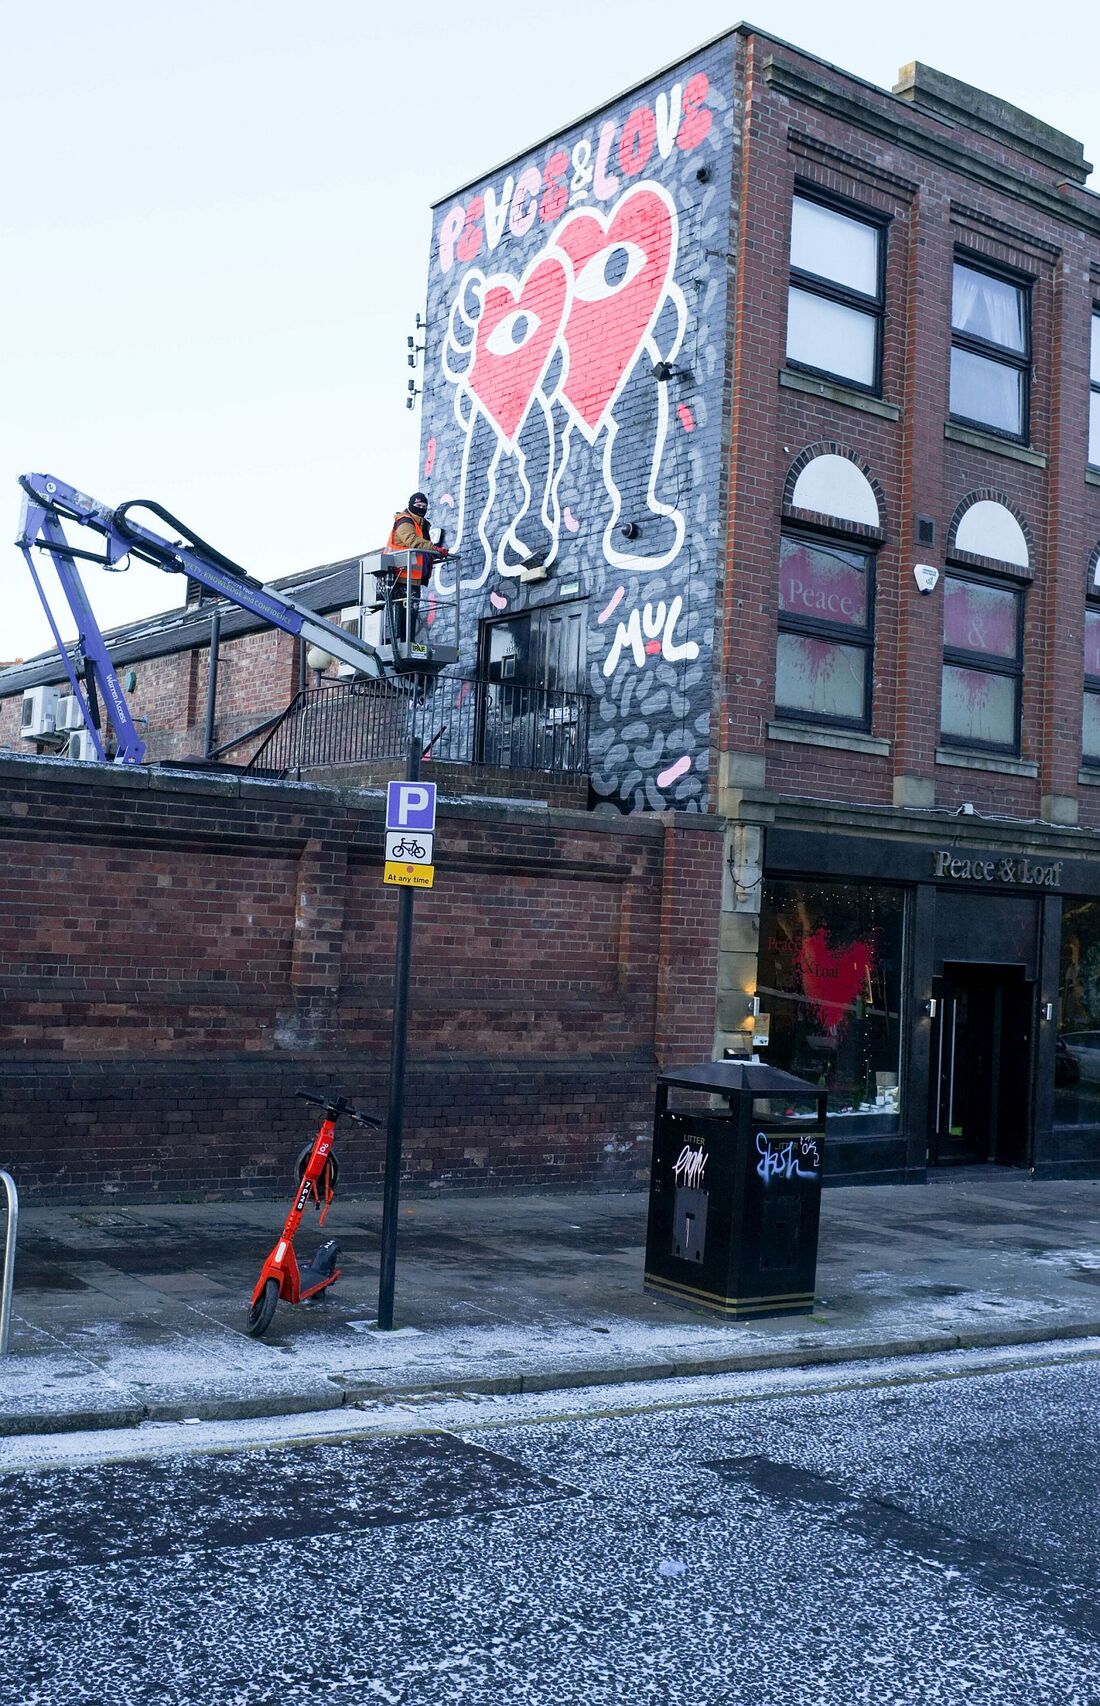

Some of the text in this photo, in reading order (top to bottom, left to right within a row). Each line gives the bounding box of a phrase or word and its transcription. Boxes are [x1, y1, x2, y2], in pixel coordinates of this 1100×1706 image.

[789, 578, 853, 615] Peace
[968, 618, 988, 649] &
[399, 786, 429, 825] P
[388, 873, 429, 884] At any time
[933, 850, 1063, 887] Peace & Loaf
[683, 1133, 705, 1146] LITTER
